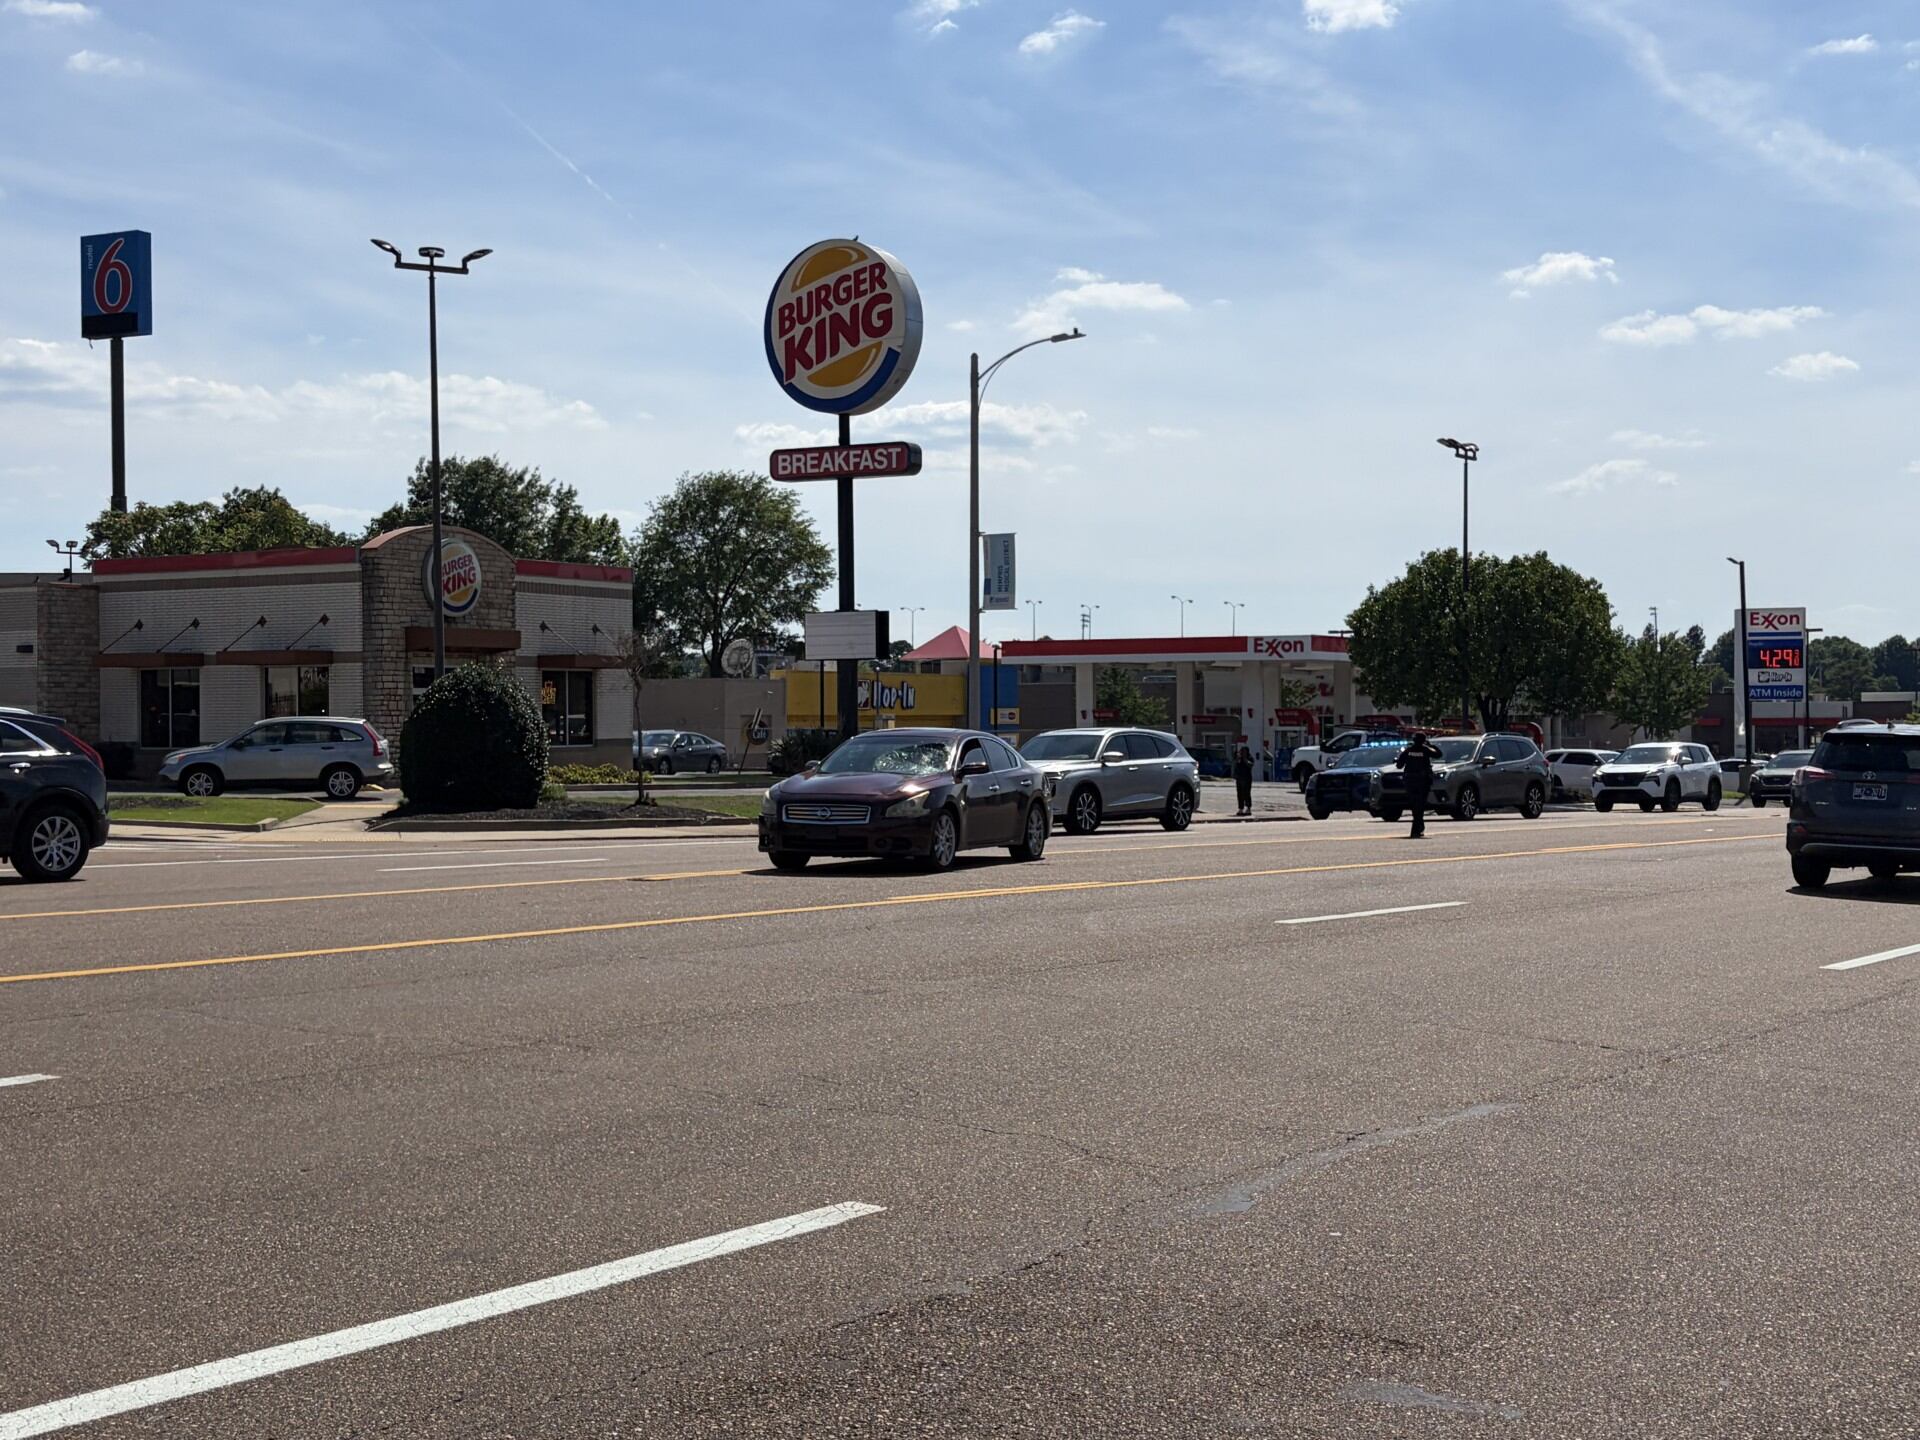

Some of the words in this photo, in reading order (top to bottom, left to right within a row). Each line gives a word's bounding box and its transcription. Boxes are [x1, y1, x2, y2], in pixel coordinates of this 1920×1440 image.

[93, 237, 132, 314] 6
[778, 261, 888, 339] BURGER
[783, 292, 894, 384] KING
[777, 447, 902, 476] BREAKFAST
[442, 566, 476, 596] KING
[1750, 611, 1800, 631] Exxon
[1253, 637, 1305, 658] Exxon
[1749, 688, 1771, 697] ATM
[1773, 687, 1802, 697] Inside
